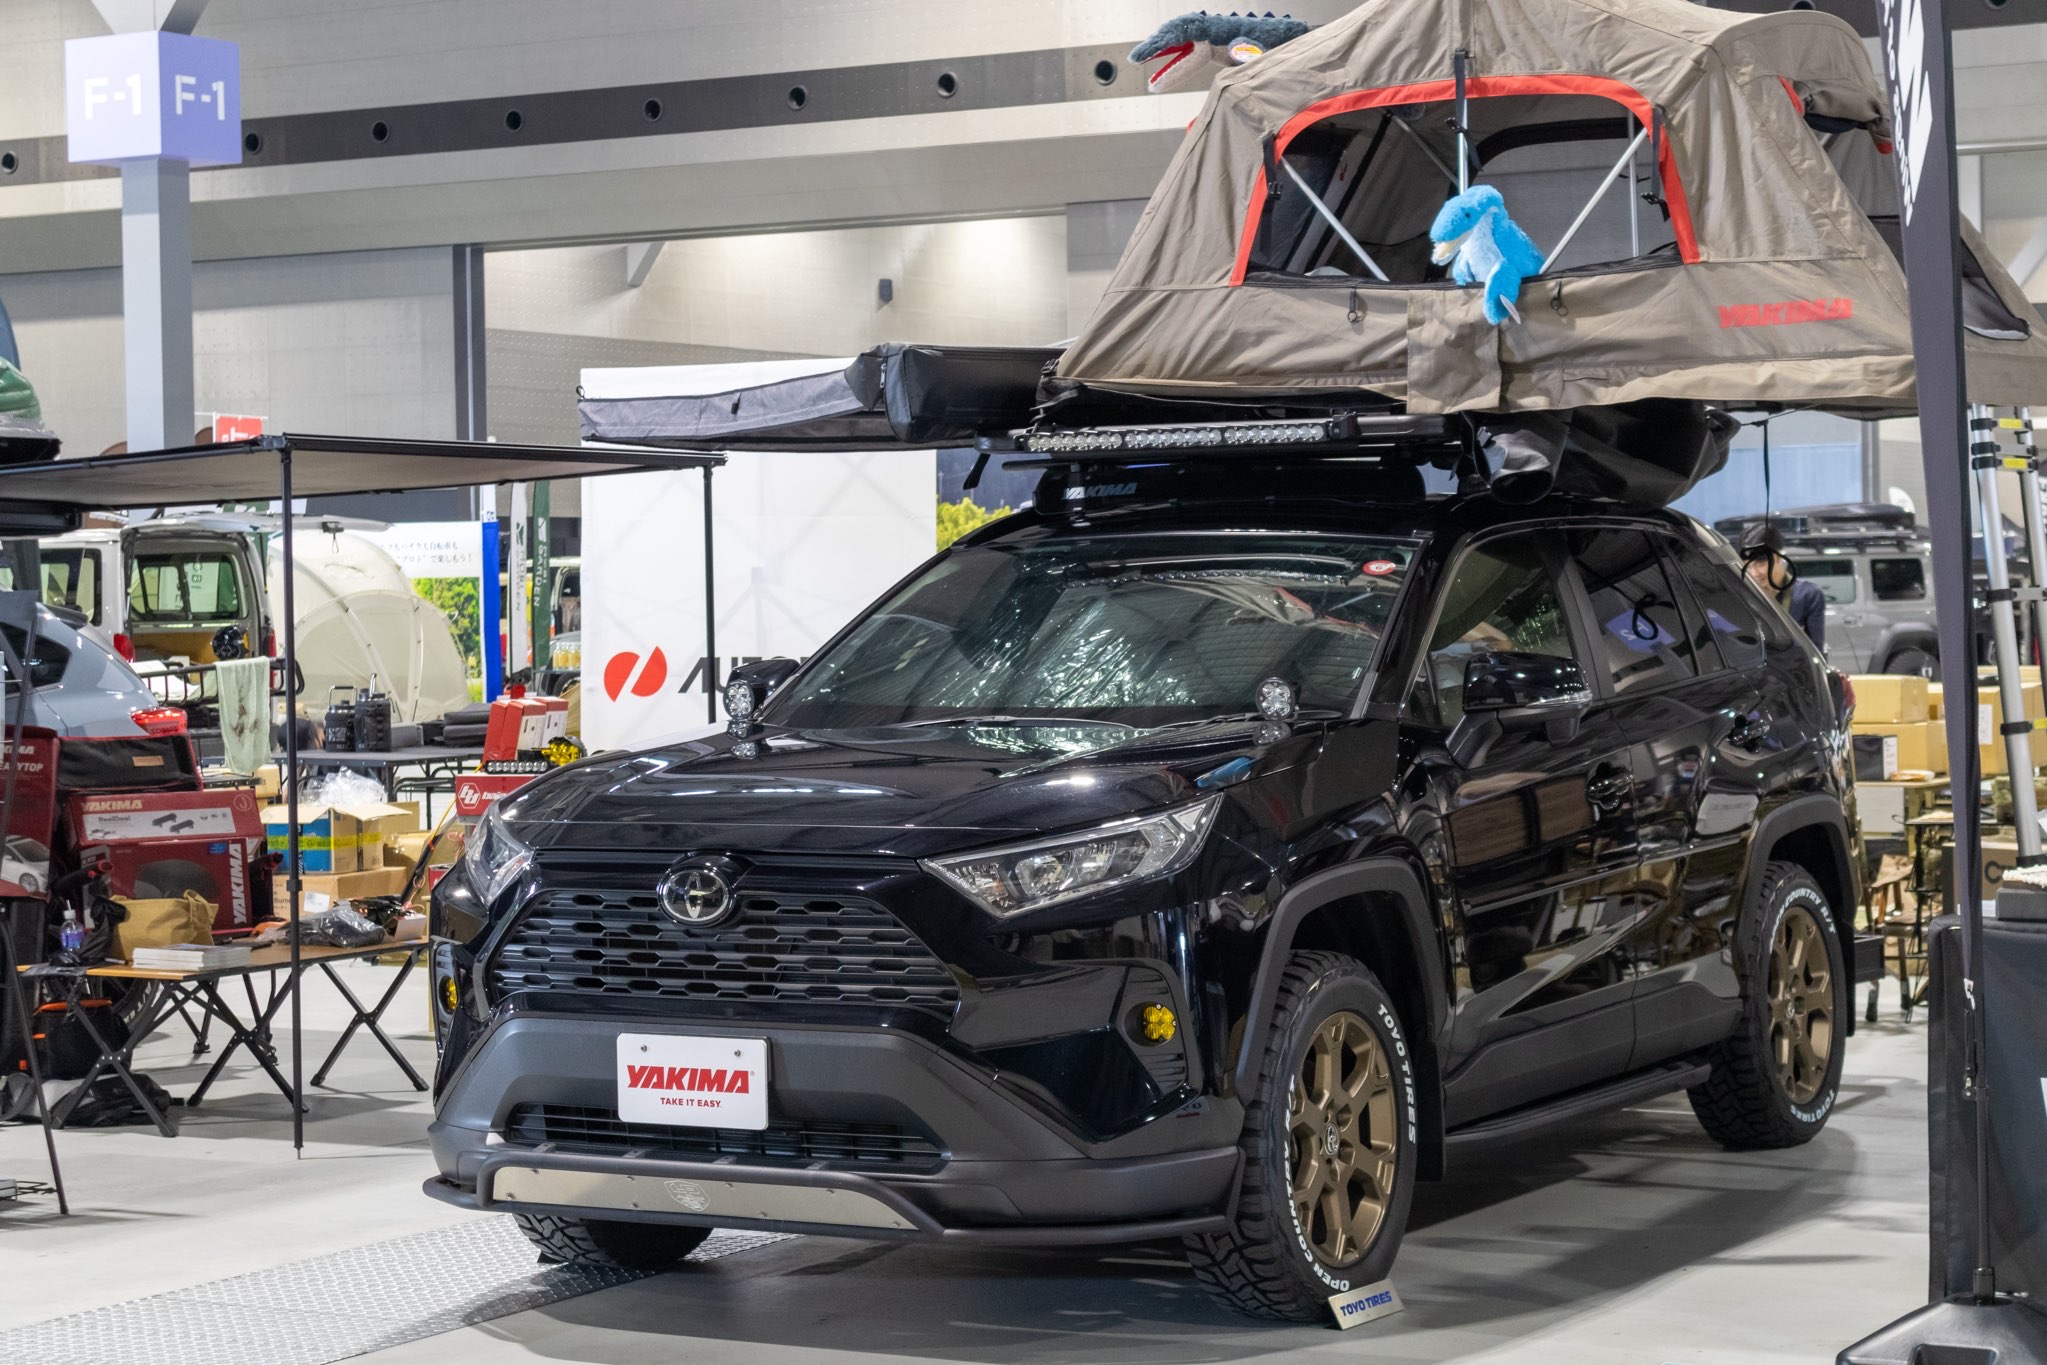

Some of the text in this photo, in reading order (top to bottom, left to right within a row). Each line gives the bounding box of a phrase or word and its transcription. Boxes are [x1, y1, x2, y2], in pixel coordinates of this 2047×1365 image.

[84, 73, 142, 121] F-1
[175, 74, 226, 121] F-1
[1718, 297, 1854, 329] YAKIMA
[1062, 482, 1138, 500] YAKIMA
[80, 799, 143, 812] YAKIMA
[98, 814, 131, 822] ReelDeal
[229, 843, 248, 925] YAKIMA
[1785, 887, 1822, 908] COUNTRY
[1820, 906, 1836, 934] R/T
[627, 1064, 750, 1094] YAKIMA
[1377, 1003, 1417, 1144] TOYO TIRES
[660, 1097, 721, 1108] TAKE IT EASY
[1284, 1140, 1313, 1263] COUNTRY
[1313, 1262, 1350, 1292] OPEN
[1340, 1290, 1393, 1317] TOYO TIRES
